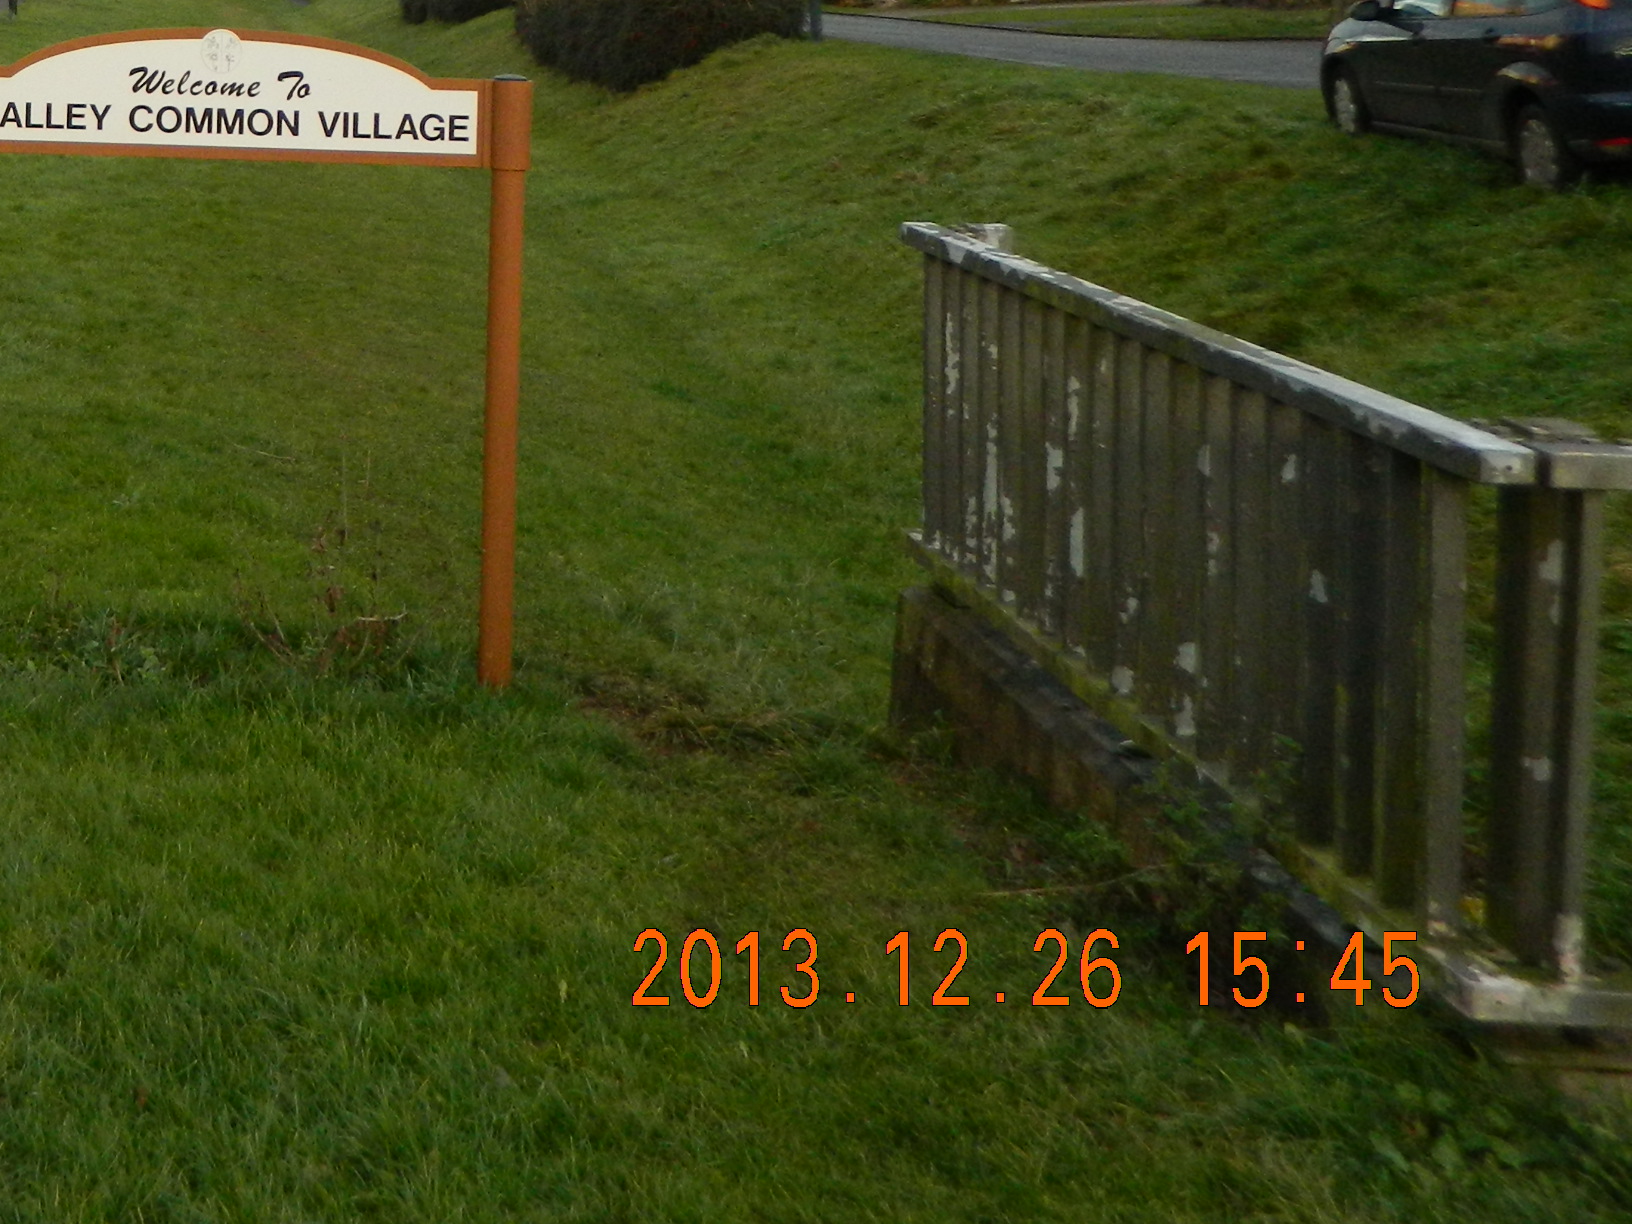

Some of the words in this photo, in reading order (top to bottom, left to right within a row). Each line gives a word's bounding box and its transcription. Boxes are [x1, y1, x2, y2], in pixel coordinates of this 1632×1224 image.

[128, 66, 261, 98] Welcome
[277, 70, 311, 101] To
[128, 104, 300, 137] COMMON
[317, 110, 470, 142] VILLAGE
